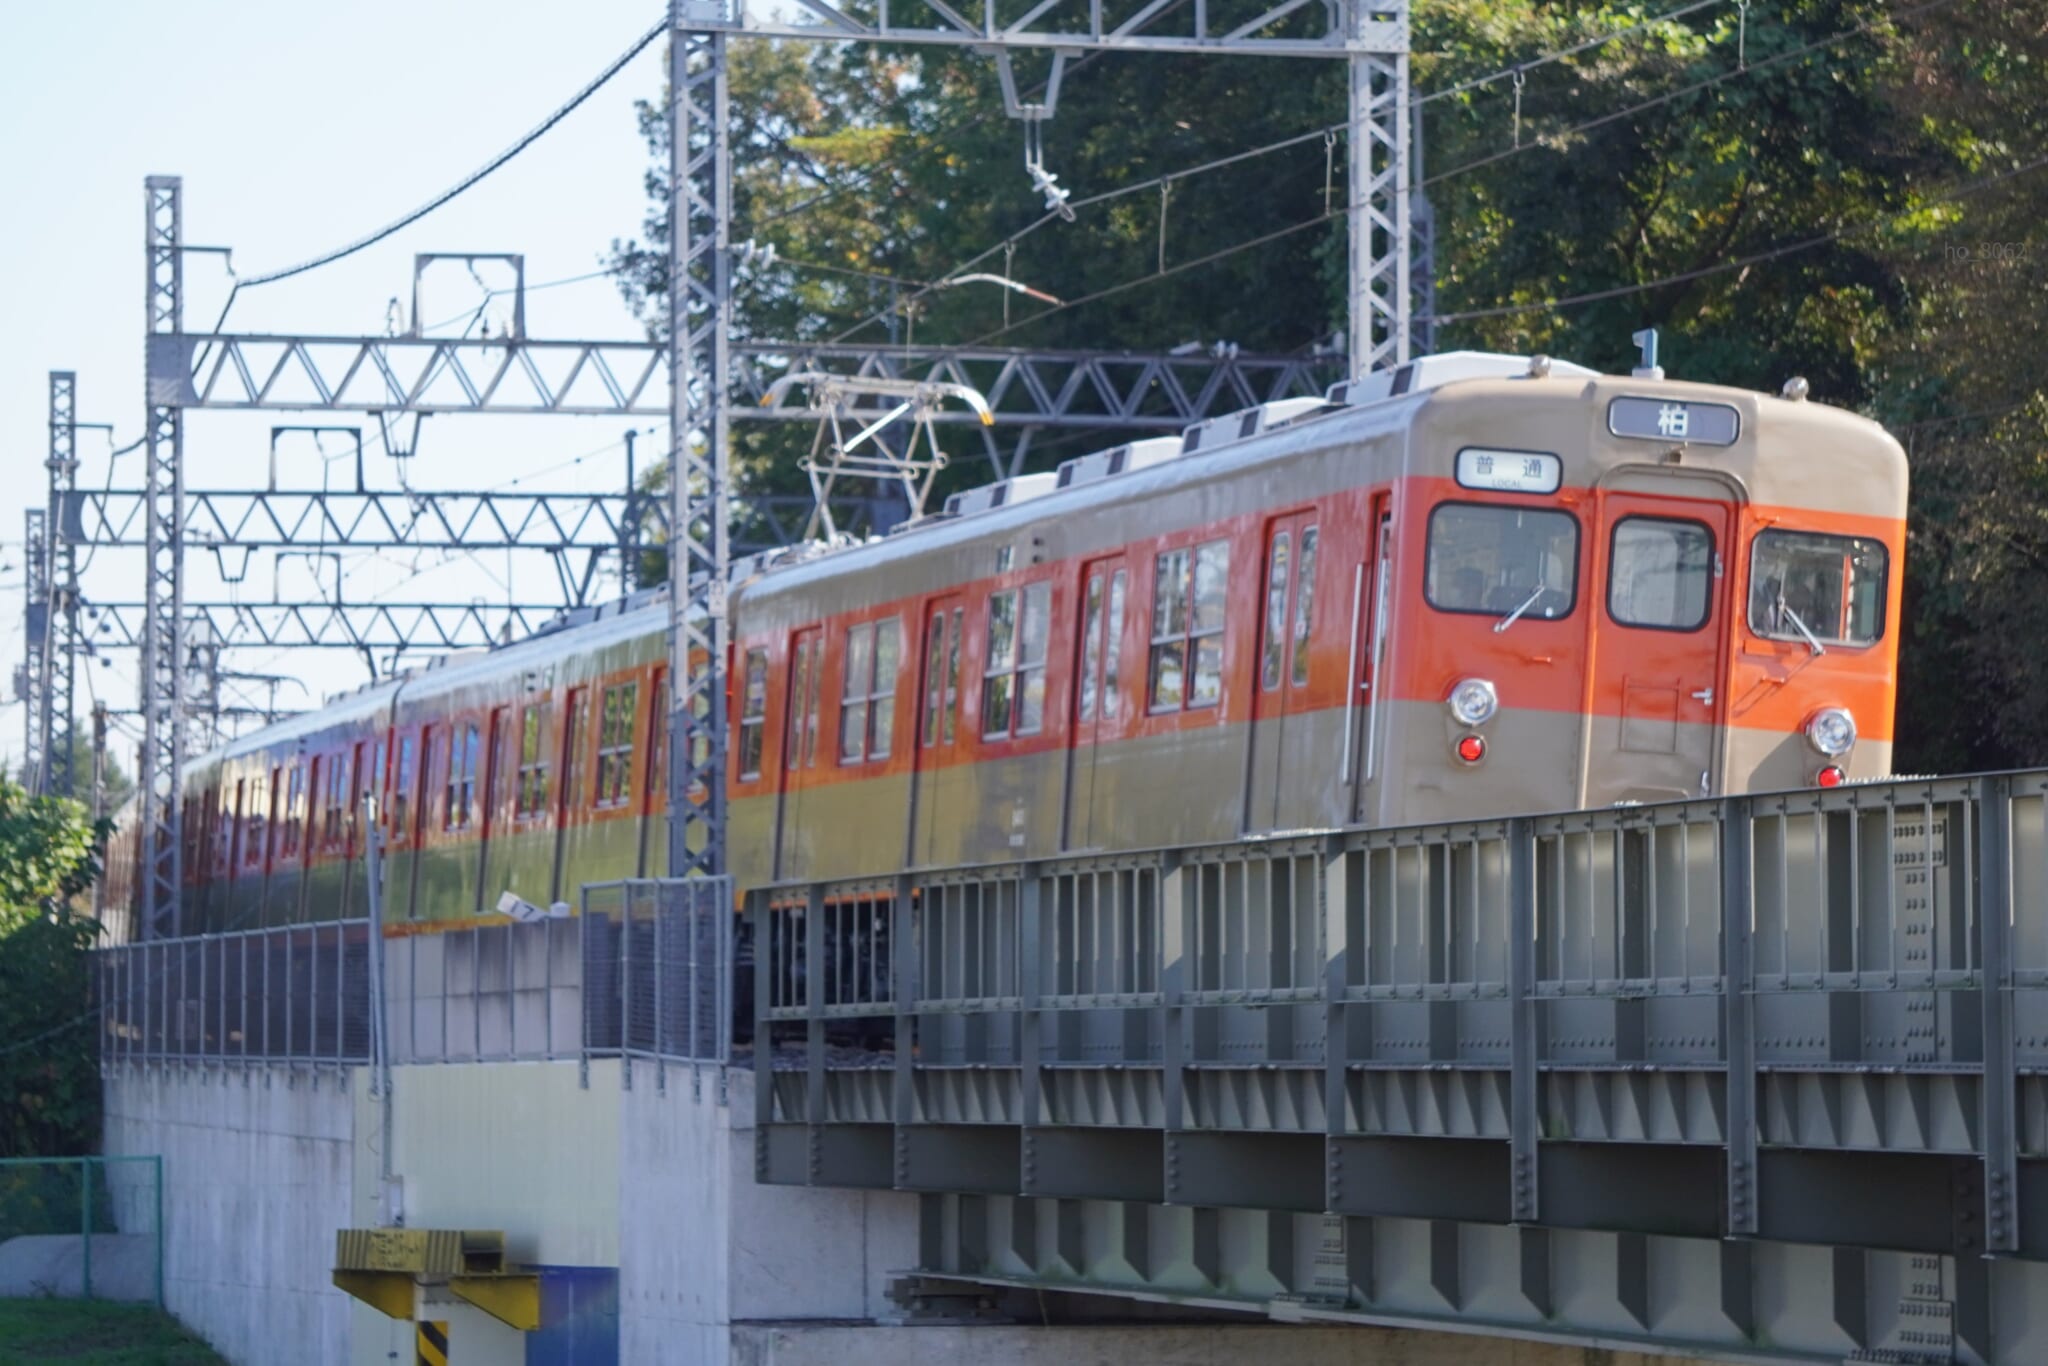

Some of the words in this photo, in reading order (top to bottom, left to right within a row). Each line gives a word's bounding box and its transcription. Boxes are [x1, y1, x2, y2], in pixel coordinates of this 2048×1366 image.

[1657, 402, 1689, 437] 柏
[1476, 455, 1542, 478] 普通
[1491, 478, 1522, 489] LOCAL
